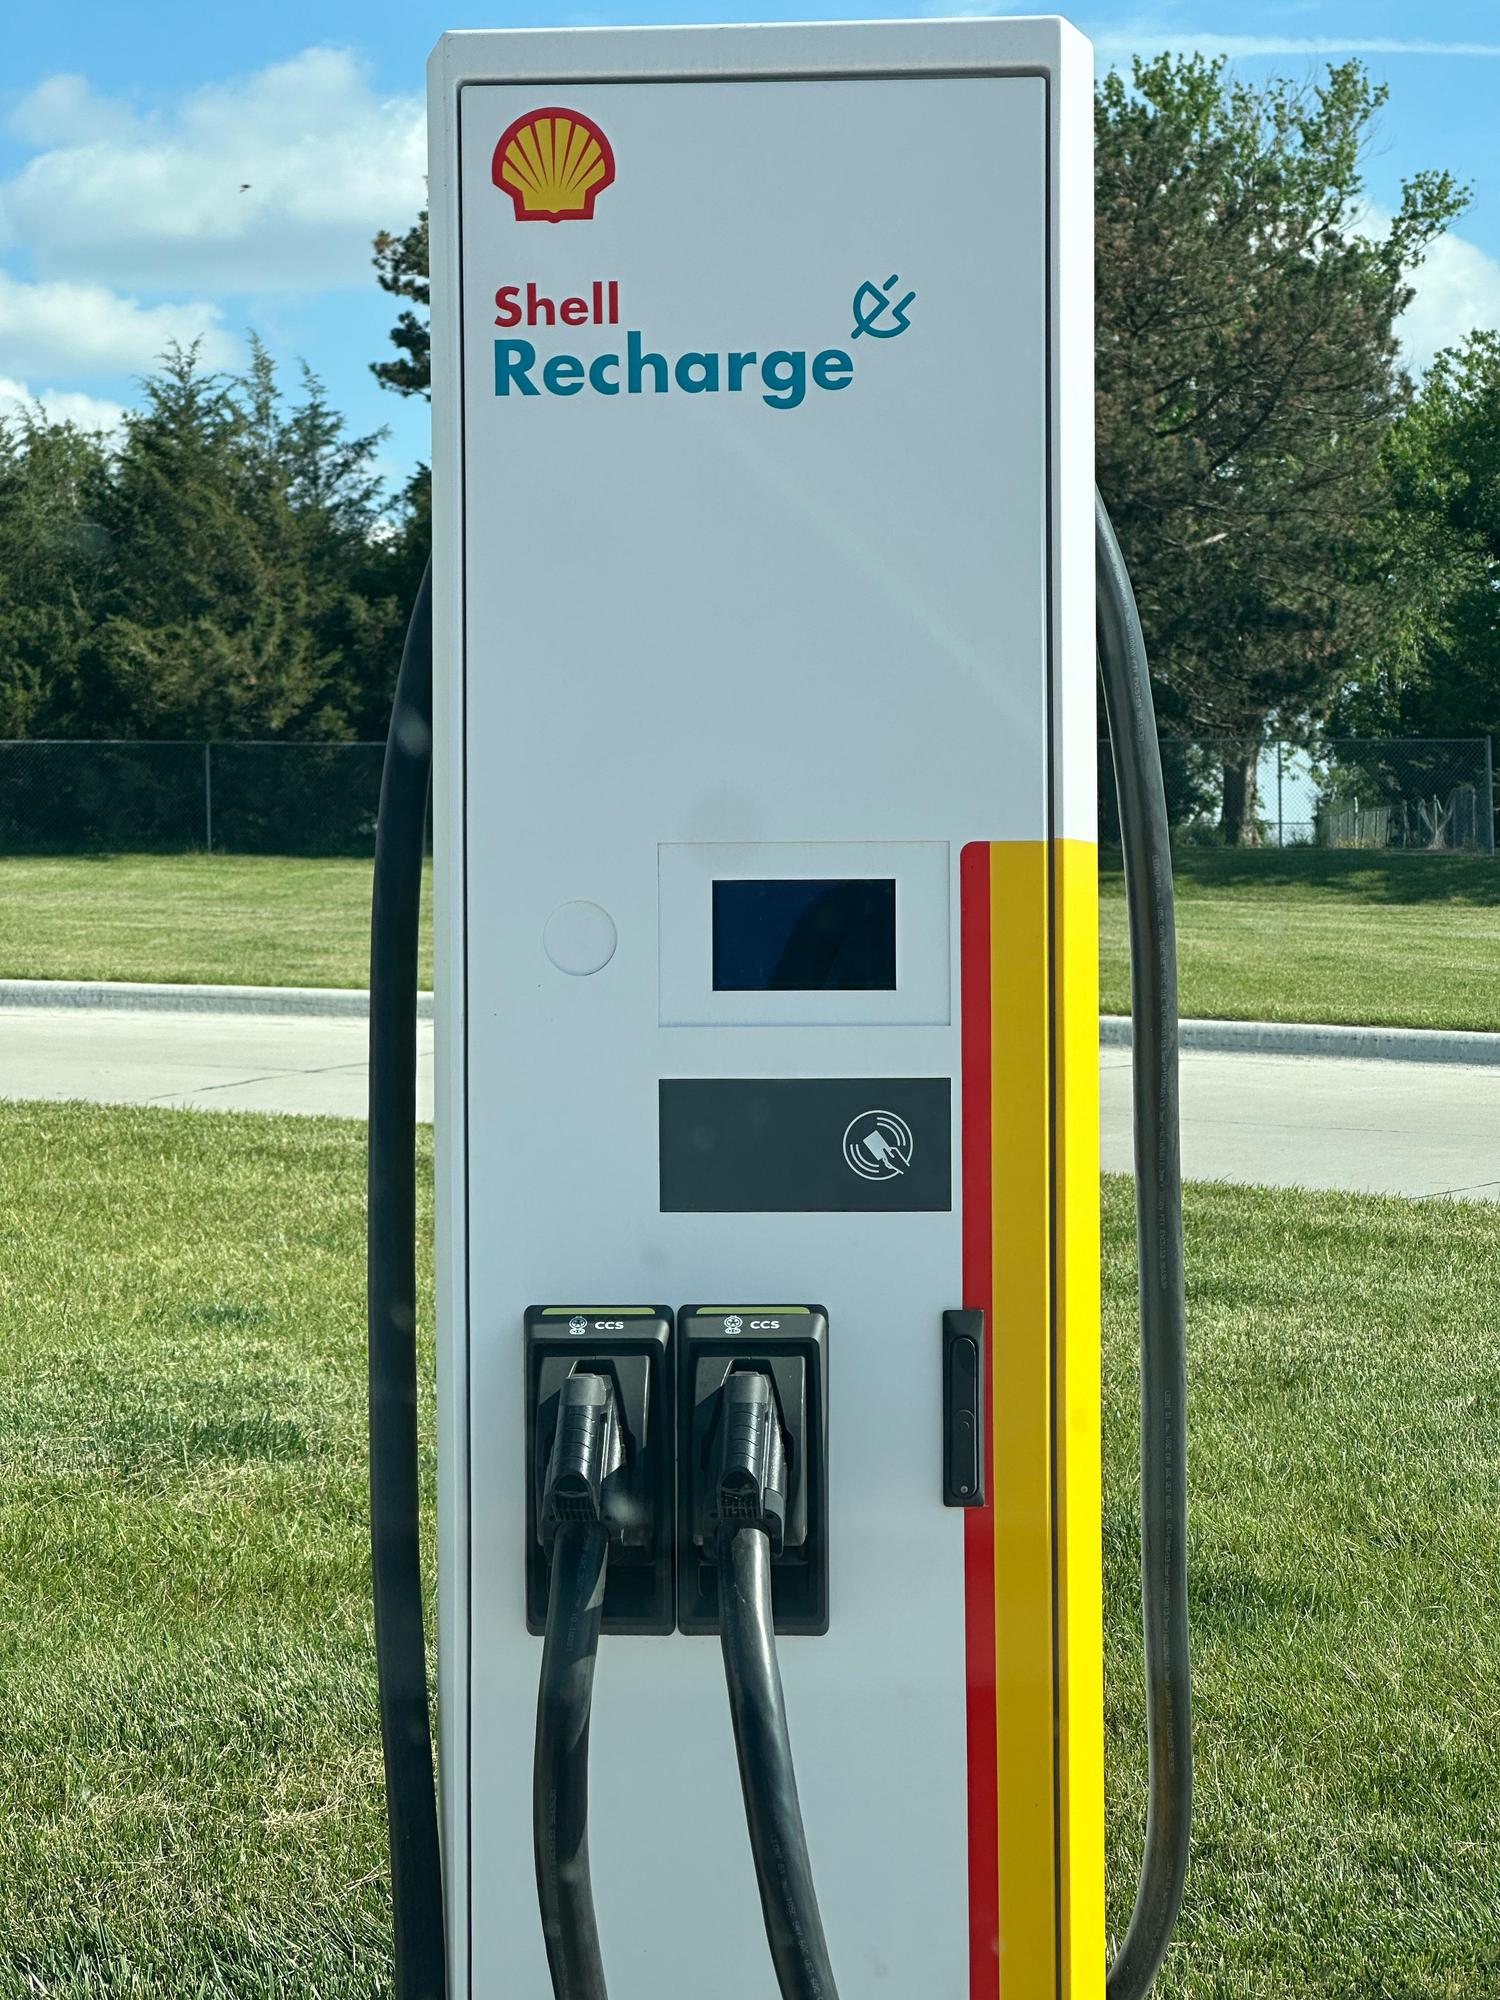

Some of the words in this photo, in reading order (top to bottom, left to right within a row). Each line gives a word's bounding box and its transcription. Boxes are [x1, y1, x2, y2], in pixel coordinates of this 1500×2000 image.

[494, 281, 618, 327] Shell
[494, 331, 854, 410] Recharge
[594, 1321, 624, 1330] CCS
[749, 1320, 780, 1329] CCS
